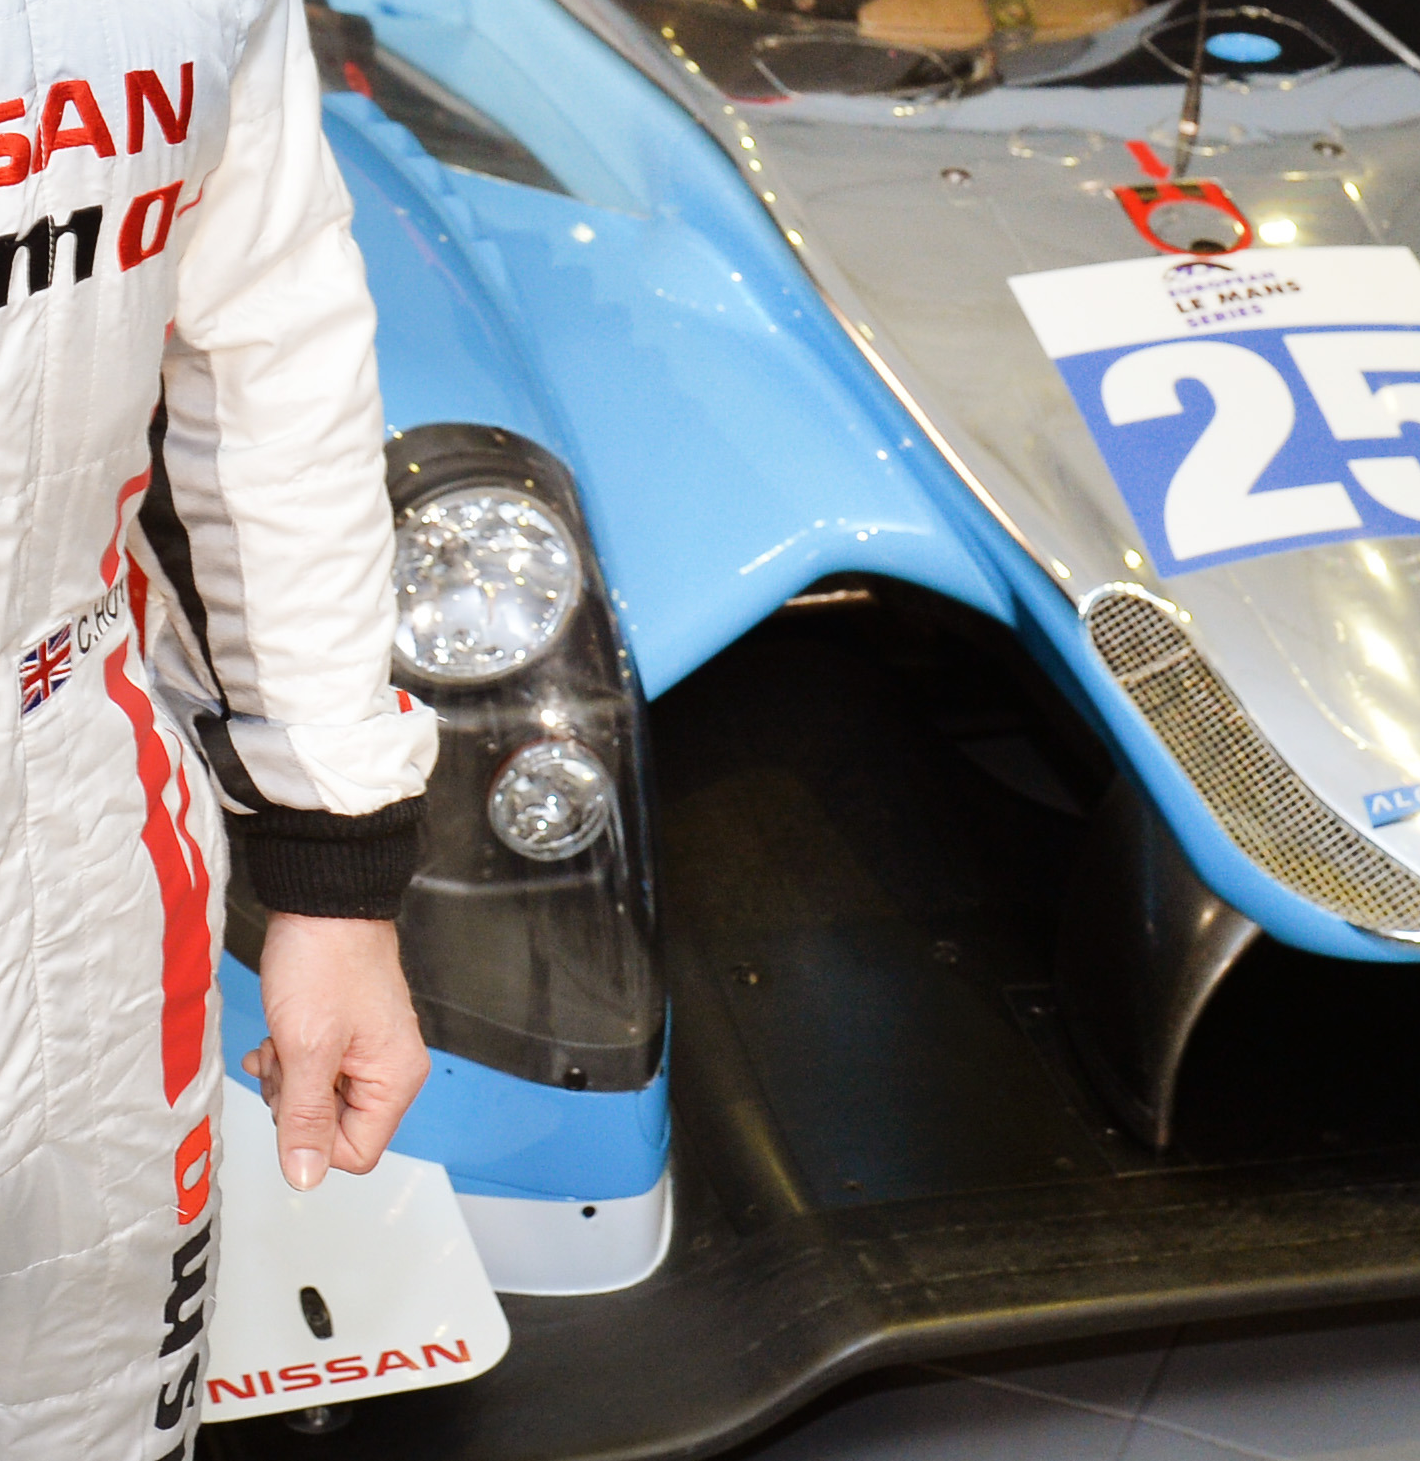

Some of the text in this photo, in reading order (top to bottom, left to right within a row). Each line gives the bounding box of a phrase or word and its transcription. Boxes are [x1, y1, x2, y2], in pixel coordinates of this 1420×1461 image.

[1175, 281, 1301, 314] LE MANS
[1187, 304, 1263, 327] SERIES
[206, 1338, 474, 1405] NISSAN
